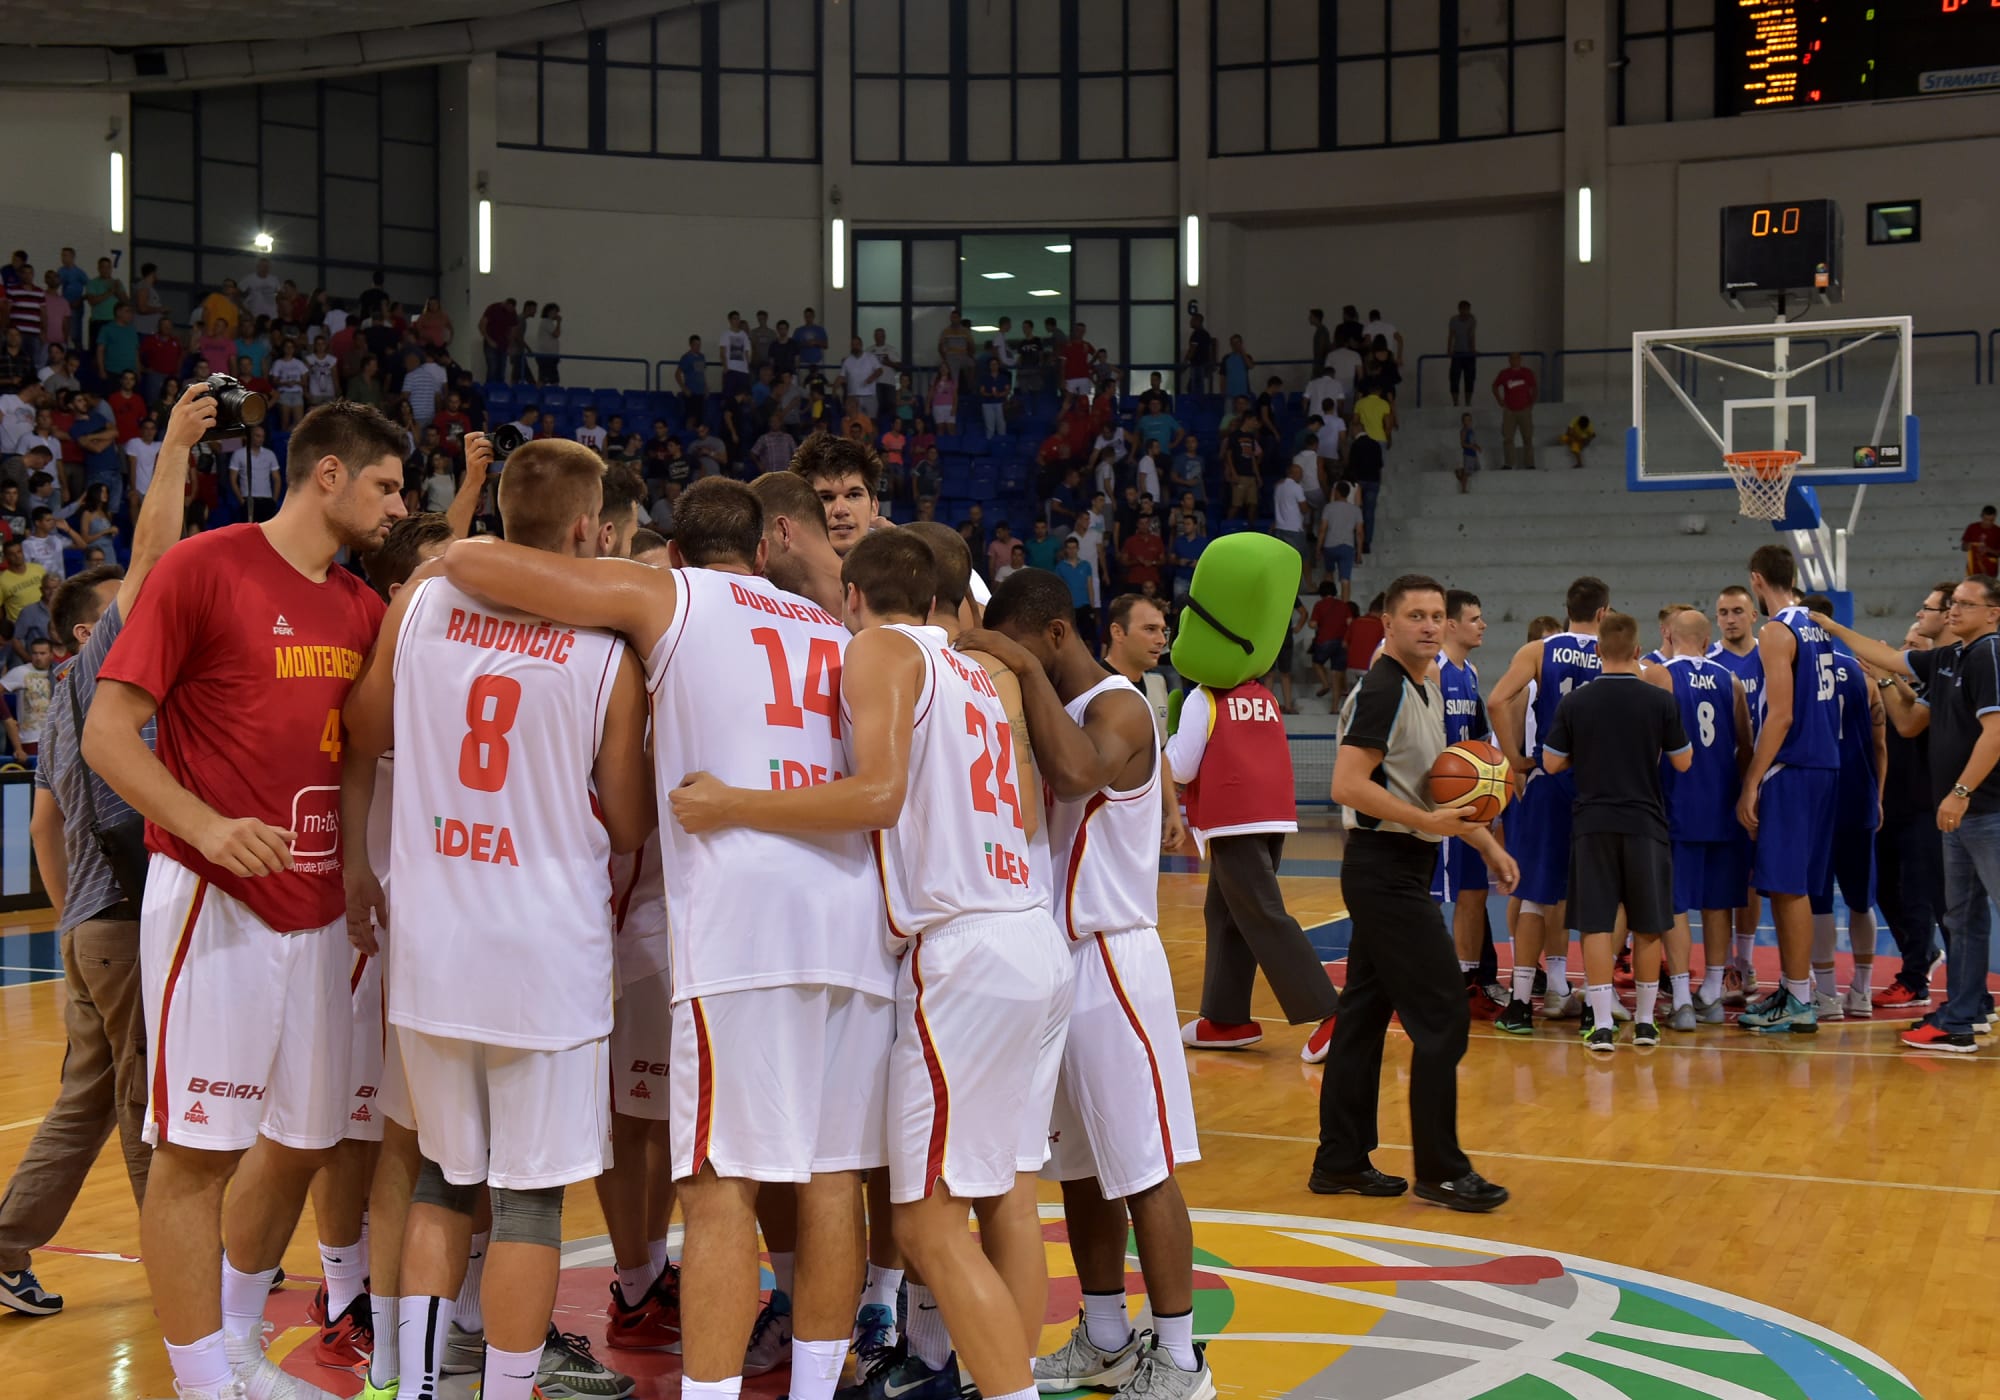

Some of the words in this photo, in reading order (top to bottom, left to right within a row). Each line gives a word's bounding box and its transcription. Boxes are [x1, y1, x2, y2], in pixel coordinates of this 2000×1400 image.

[1752, 207, 1800, 236] 0.0
[111, 249, 122, 269] 7
[445, 607, 577, 665] RADONČIĆ
[751, 626, 842, 741] 14
[319, 708, 342, 763] 4
[457, 673, 523, 793] 8
[1227, 697, 1280, 723] iDEA
[1697, 701, 1716, 748] 8
[964, 700, 1025, 830] 24
[434, 816, 520, 867] iDEA
[183, 1111, 209, 1126] PEAK
